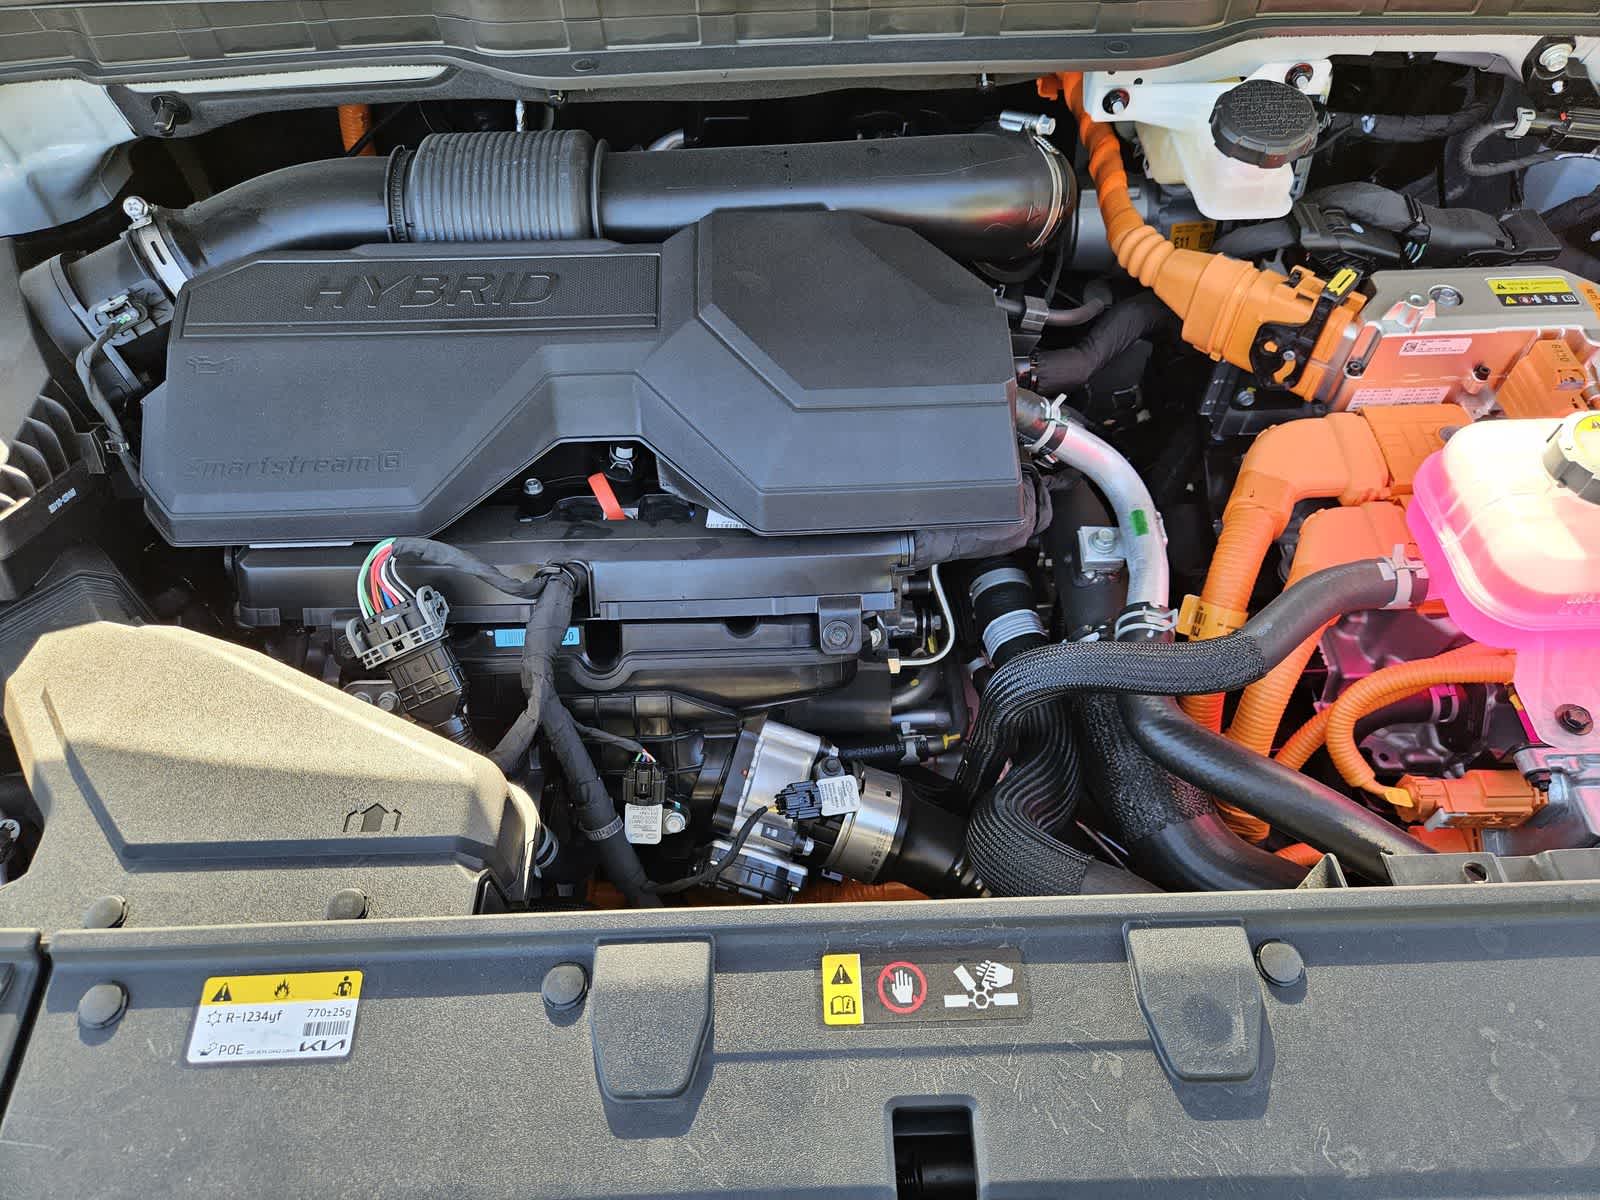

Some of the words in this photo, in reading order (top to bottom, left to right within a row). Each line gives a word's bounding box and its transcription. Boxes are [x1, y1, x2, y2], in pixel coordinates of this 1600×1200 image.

[303, 271, 560, 309] HYBRID
[226, 1009, 284, 1024] R-1234yf
[218, 1043, 246, 1056] POE
[300, 1039, 347, 1052] KIA
